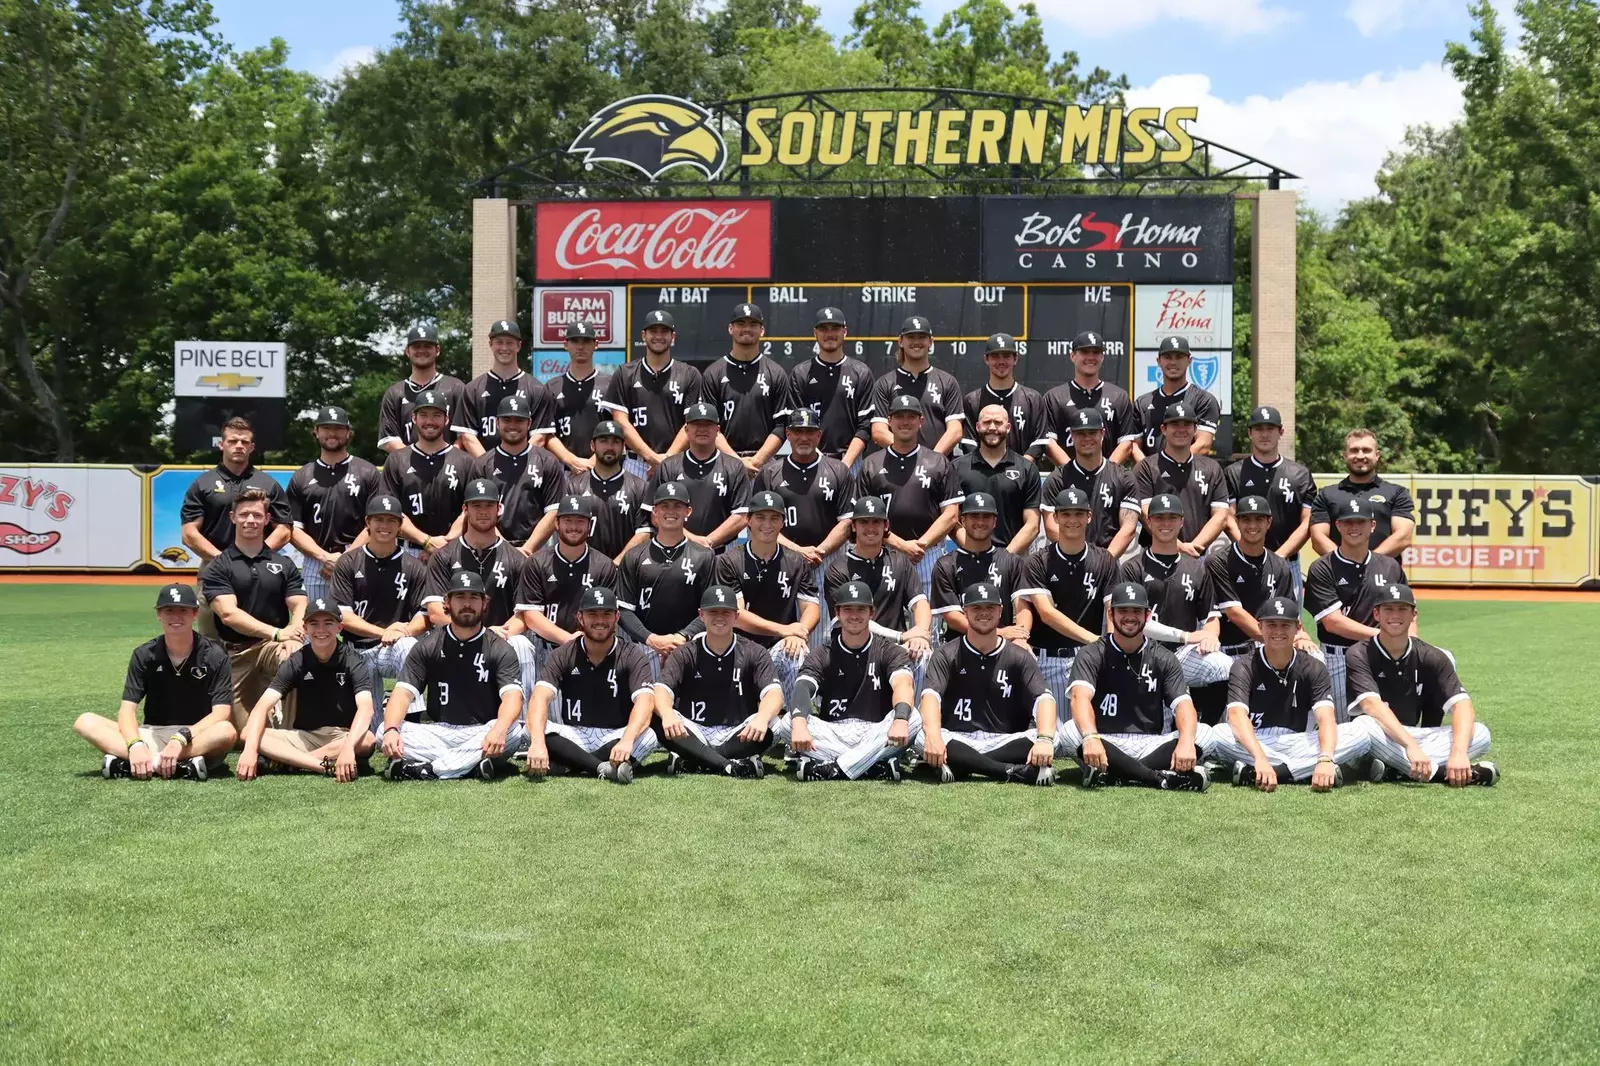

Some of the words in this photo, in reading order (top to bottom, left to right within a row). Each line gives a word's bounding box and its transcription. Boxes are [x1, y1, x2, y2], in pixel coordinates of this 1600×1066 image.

[741, 107, 1047, 166] SOUTHERN
[1059, 105, 1198, 165] MISS
[555, 208, 750, 270] Coca-Cola
[1014, 211, 1083, 247] Bok
[1114, 213, 1201, 246] Homa
[1019, 252, 1198, 268] CASINO
[563, 297, 605, 310] FARM
[658, 287, 677, 303] AT
[681, 287, 710, 303] BAT
[769, 287, 808, 303] BALL
[861, 286, 916, 303] STRIKE
[974, 286, 1006, 303] OUT
[1084, 286, 1112, 303] H/E
[1162, 288, 1207, 310] Bok
[547, 311, 606, 324] BUREAU
[1156, 309, 1212, 329] Homa
[763, 341, 771, 355] 2
[784, 341, 792, 355] 3
[855, 341, 863, 355] 6
[884, 341, 893, 355] 7
[950, 341, 967, 355] 10
[1155, 335, 1213, 344] CINO
[180, 349, 227, 367] PINE
[230, 350, 278, 368] BELT
[481, 416, 497, 437] 30
[313, 503, 321, 525] 2
[409, 492, 424, 516] 31
[4, 534, 50, 545] SHOP
[1498, 547, 1540, 567] PIT
[438, 682, 449, 706] 3
[566, 698, 582, 721] 14
[691, 701, 706, 722] 12
[953, 698, 972, 722] 43
[1099, 693, 1118, 717] 48
